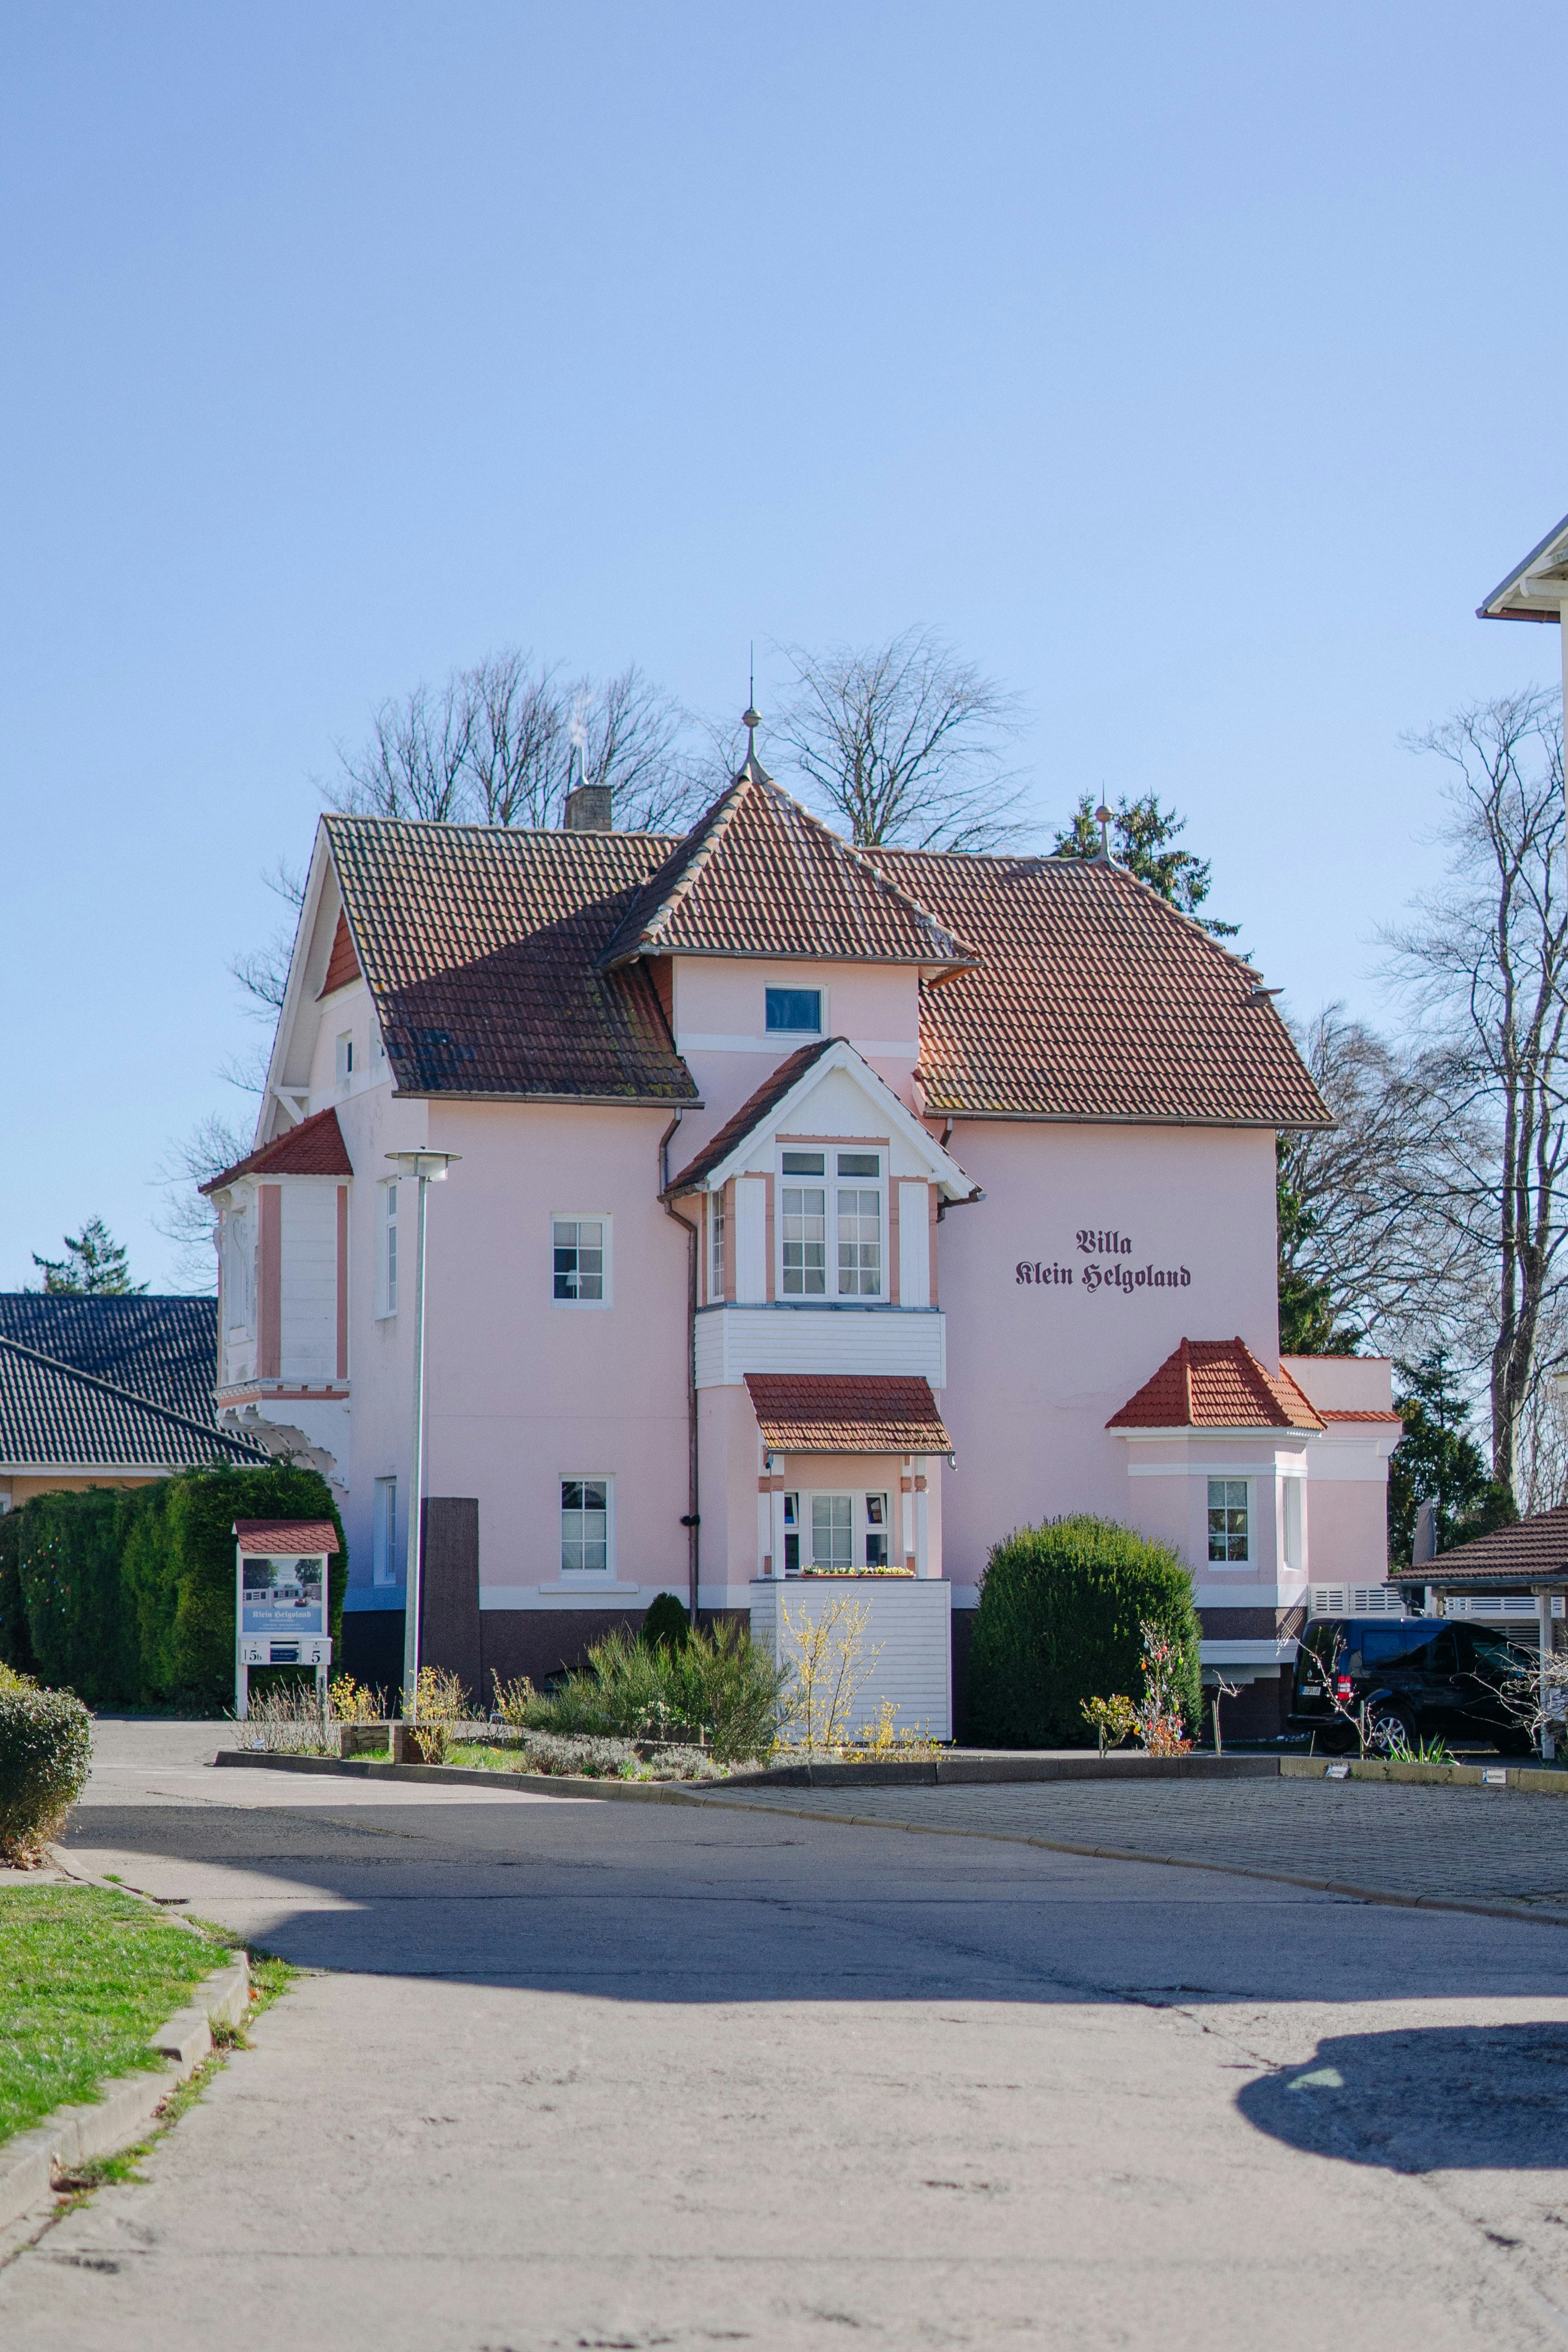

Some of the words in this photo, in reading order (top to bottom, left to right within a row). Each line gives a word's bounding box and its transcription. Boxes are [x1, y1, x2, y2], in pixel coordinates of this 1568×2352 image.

[1076, 1230, 1132, 1254] Villa
[1015, 1261, 1073, 1285] Klein
[1081, 1263, 1191, 1294] Helgoland
[244, 1649, 262, 1661] 15b
[311, 1651, 320, 1663] 5
